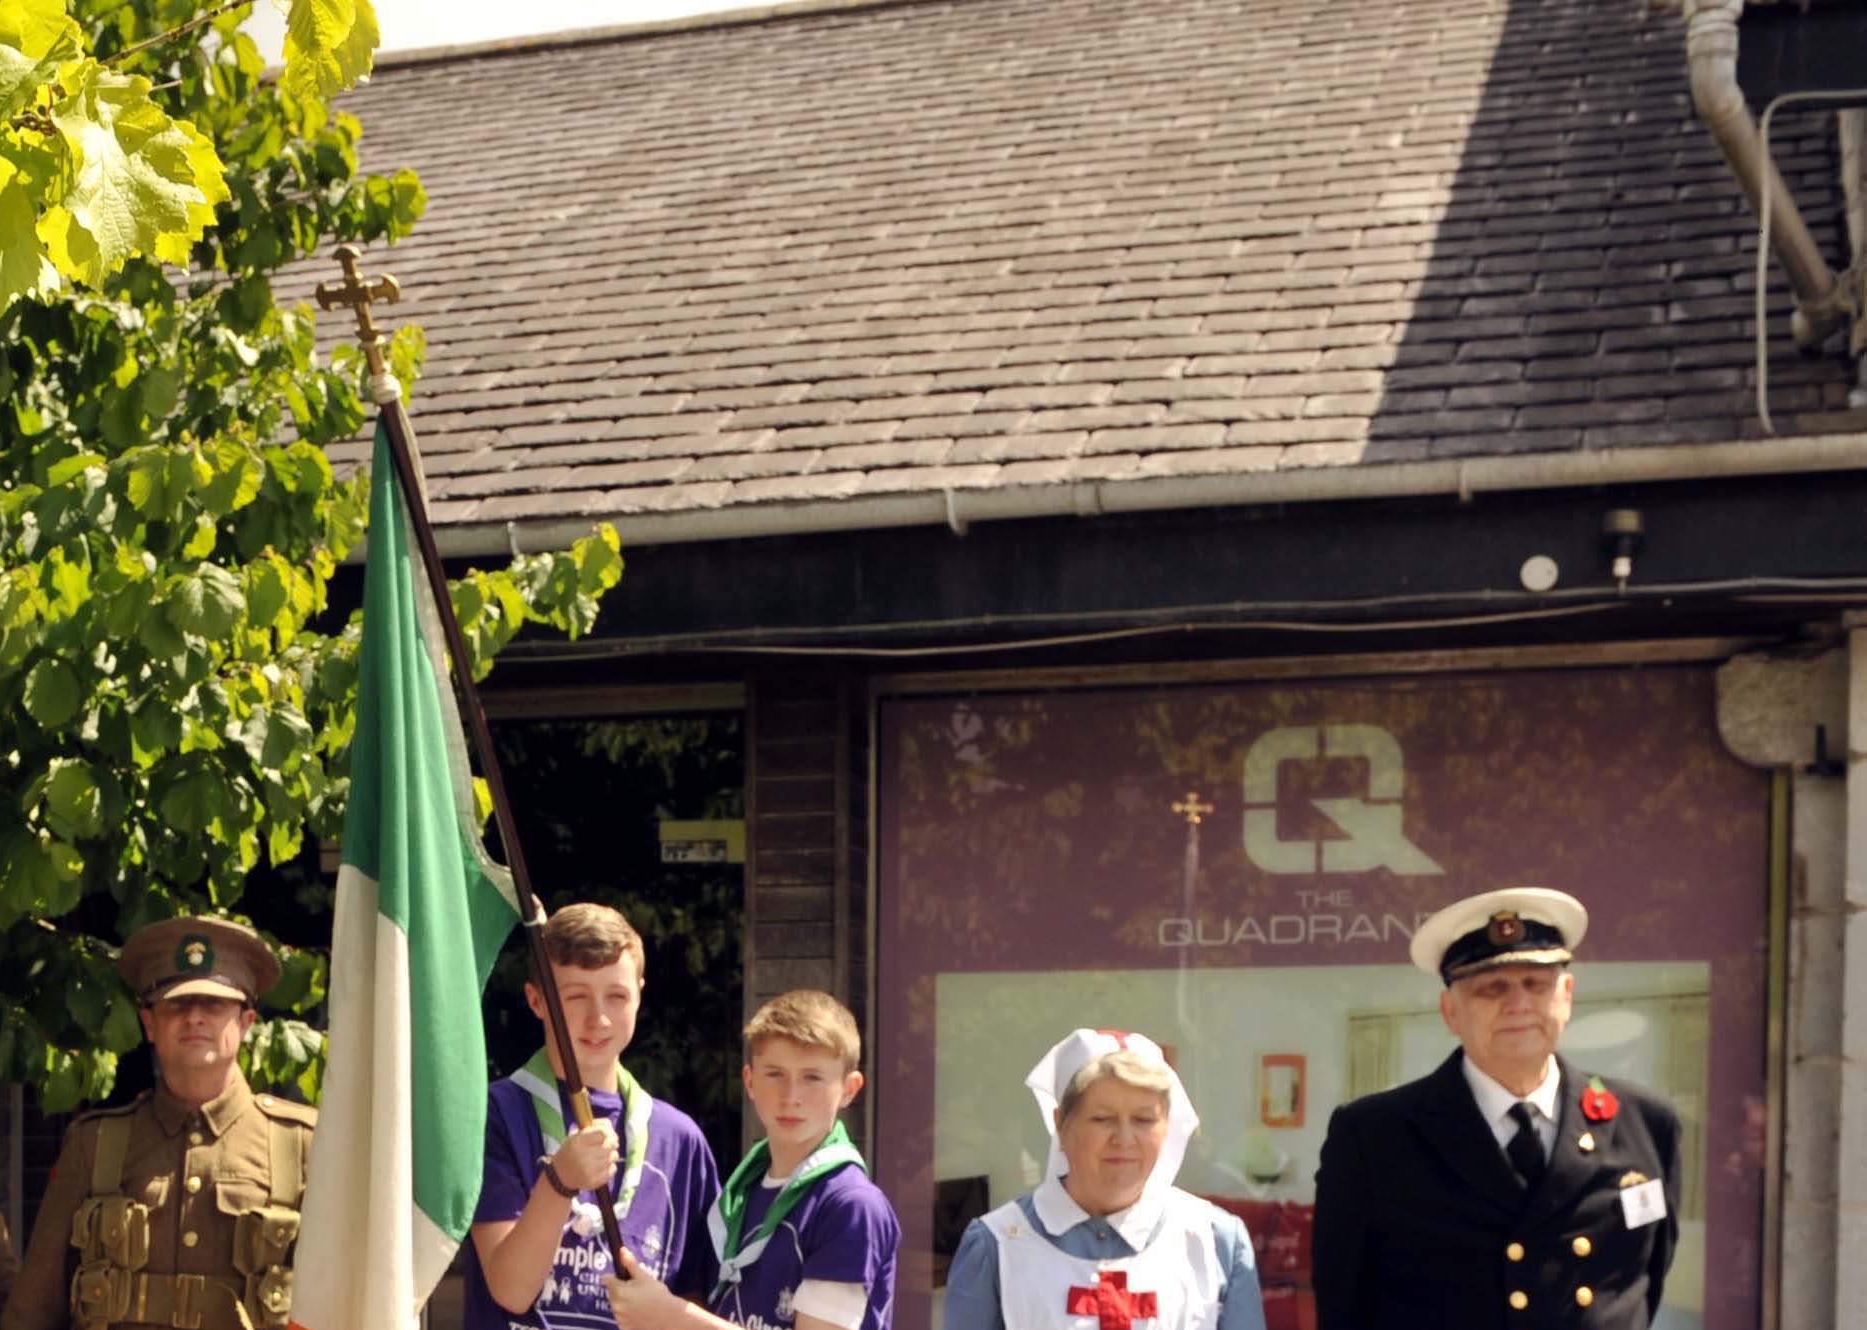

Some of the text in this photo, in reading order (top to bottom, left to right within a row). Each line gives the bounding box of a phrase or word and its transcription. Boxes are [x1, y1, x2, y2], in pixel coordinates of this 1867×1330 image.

[1243, 723, 1446, 876] Q
[1295, 889, 1353, 909] THE
[1157, 911, 1425, 947] QUADRAN
